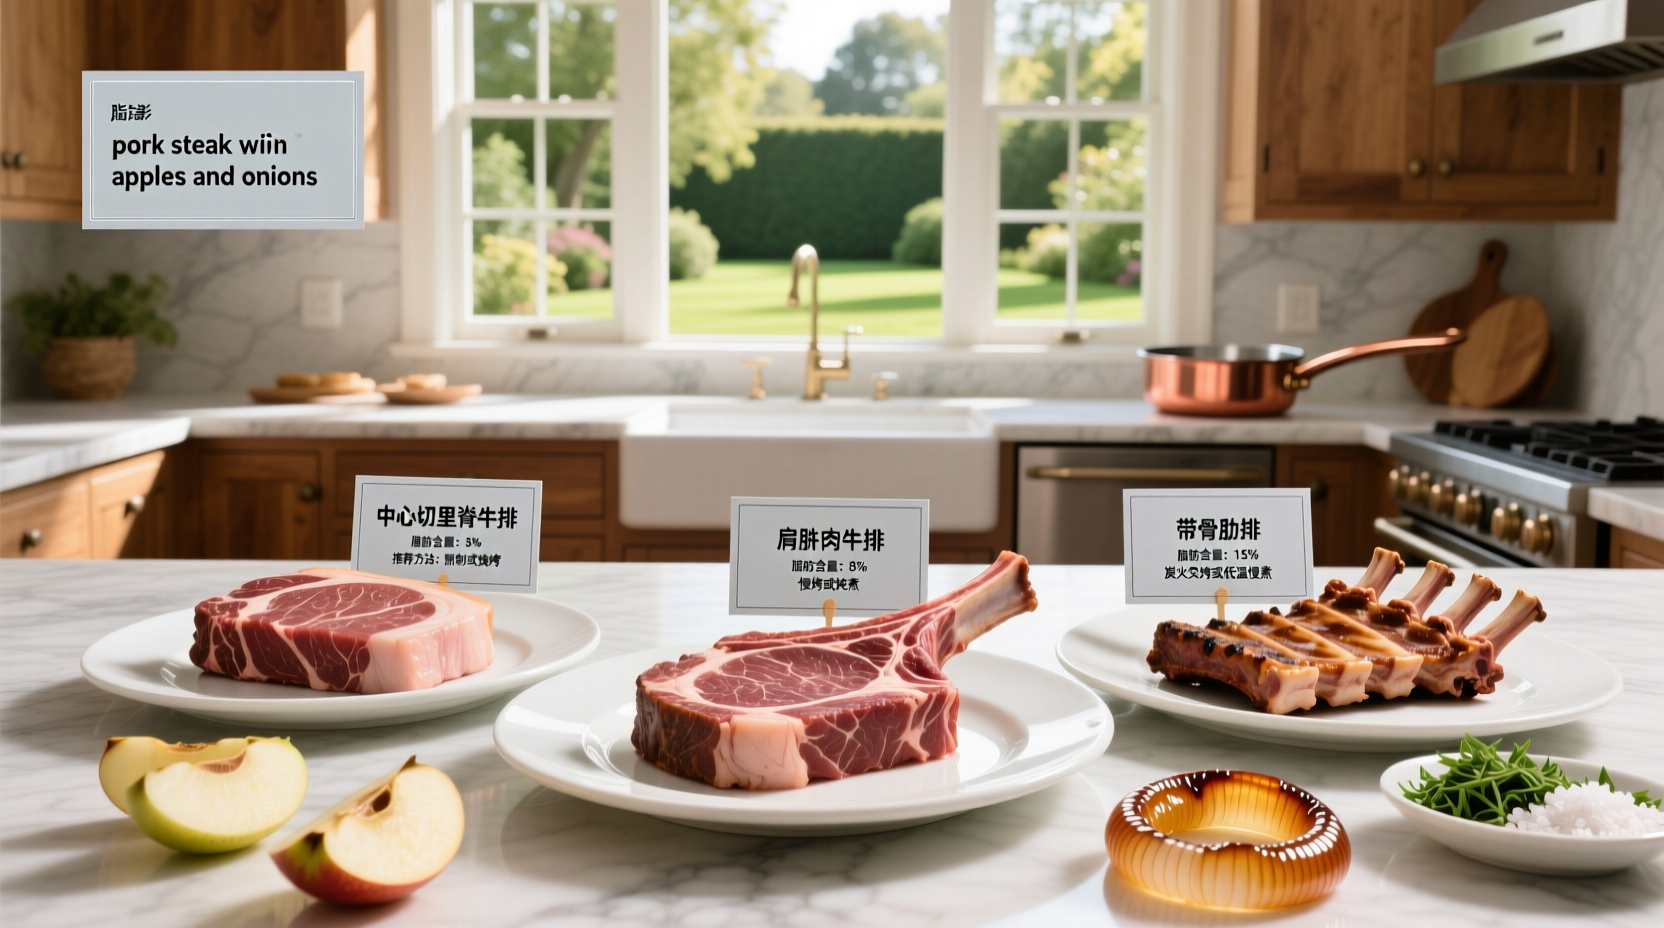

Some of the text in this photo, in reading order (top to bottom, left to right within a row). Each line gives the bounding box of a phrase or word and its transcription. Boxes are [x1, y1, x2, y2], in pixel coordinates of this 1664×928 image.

[112, 133, 165, 160] pork
[171, 133, 233, 155] steak
[112, 165, 318, 192] apples and onions
[377, 504, 518, 530] 中心切里脊牛排
[1176, 517, 1261, 541] 带骨肋排
